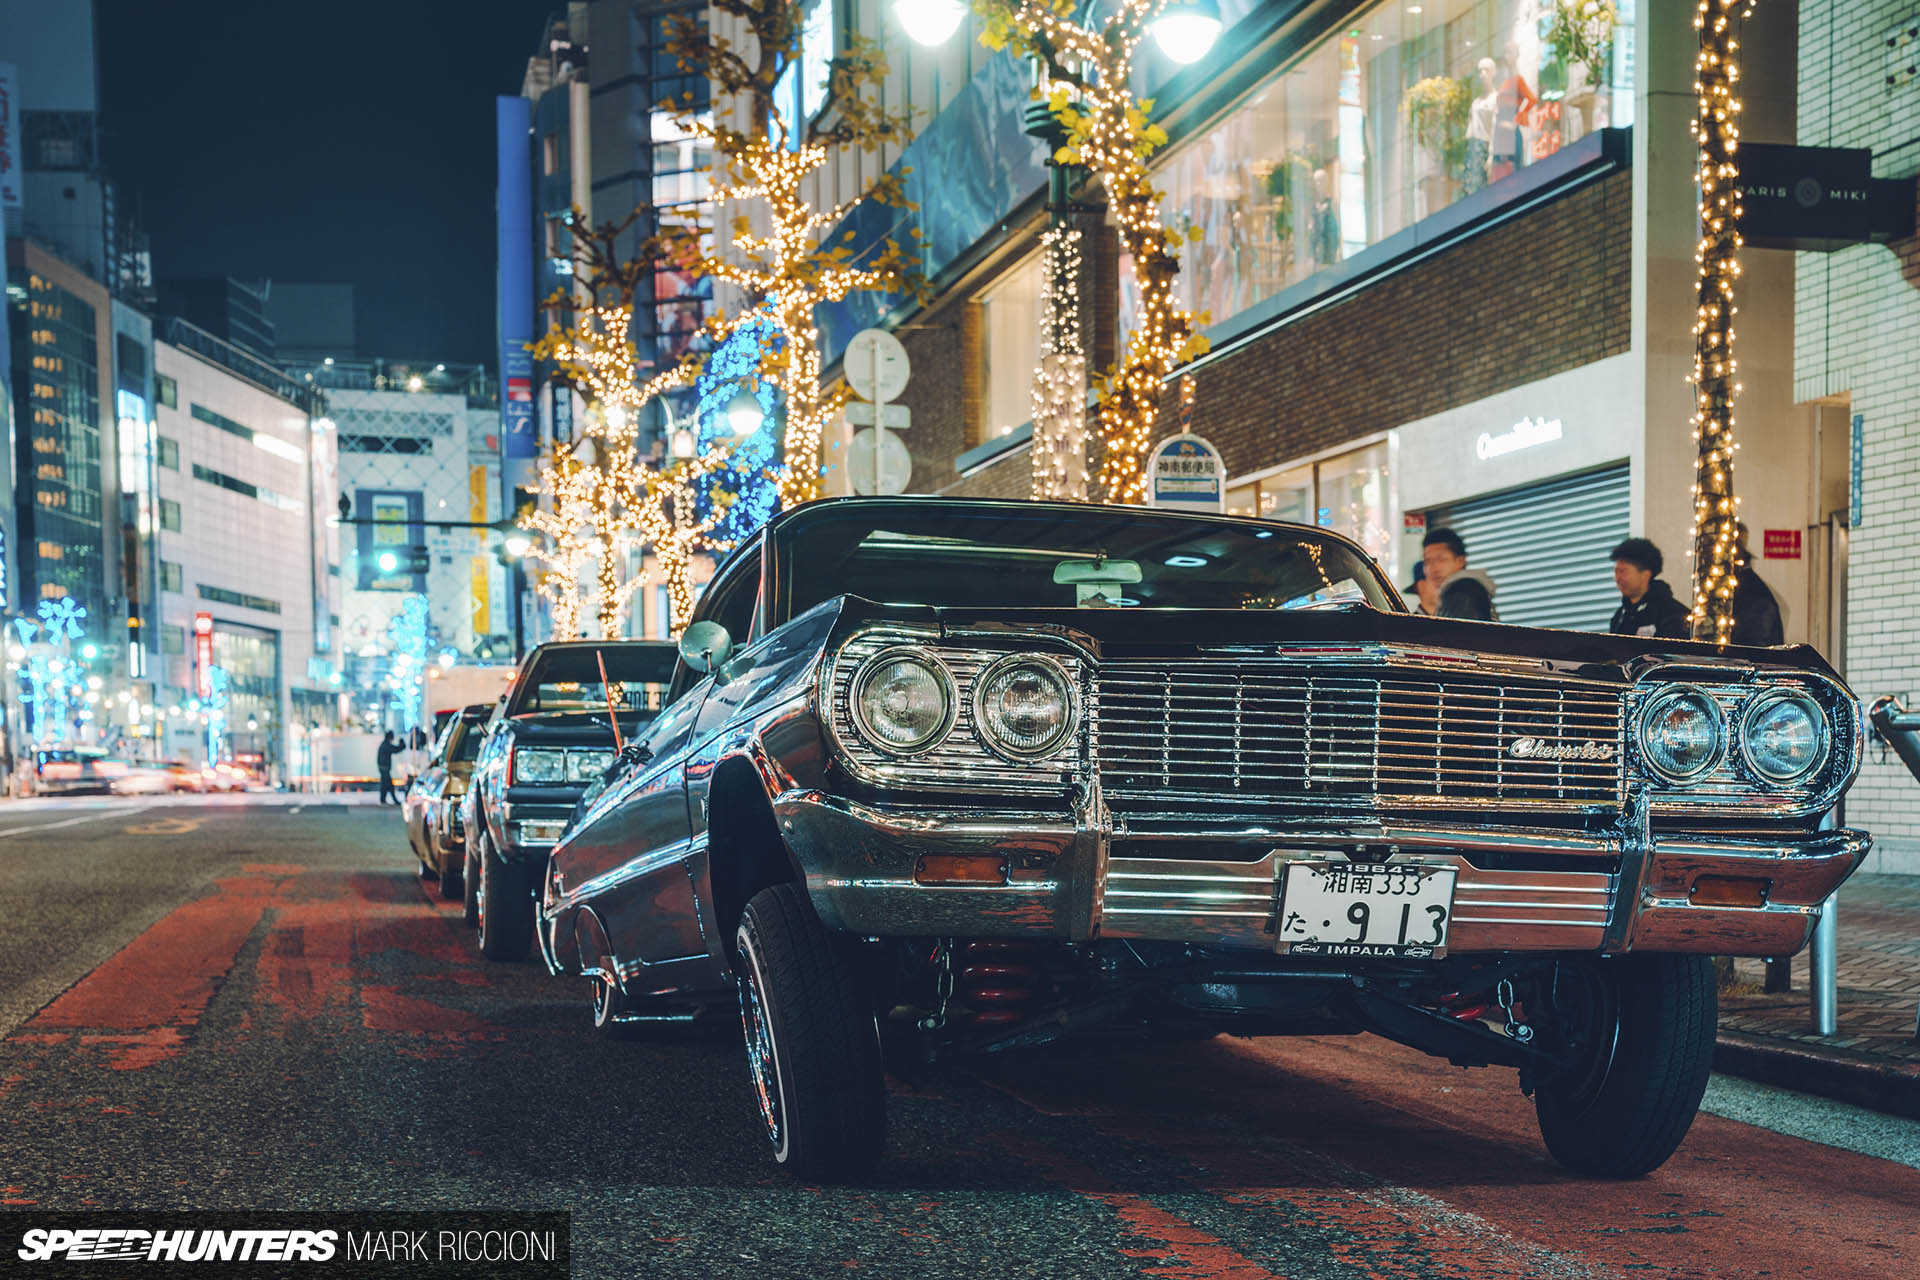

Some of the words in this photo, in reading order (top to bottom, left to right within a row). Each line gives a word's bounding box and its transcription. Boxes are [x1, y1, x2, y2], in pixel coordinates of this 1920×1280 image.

[1830, 189, 1866, 200] MIKI
[1509, 737, 1614, 760] Chevrolet
[1327, 944, 1396, 956] IMPALA
